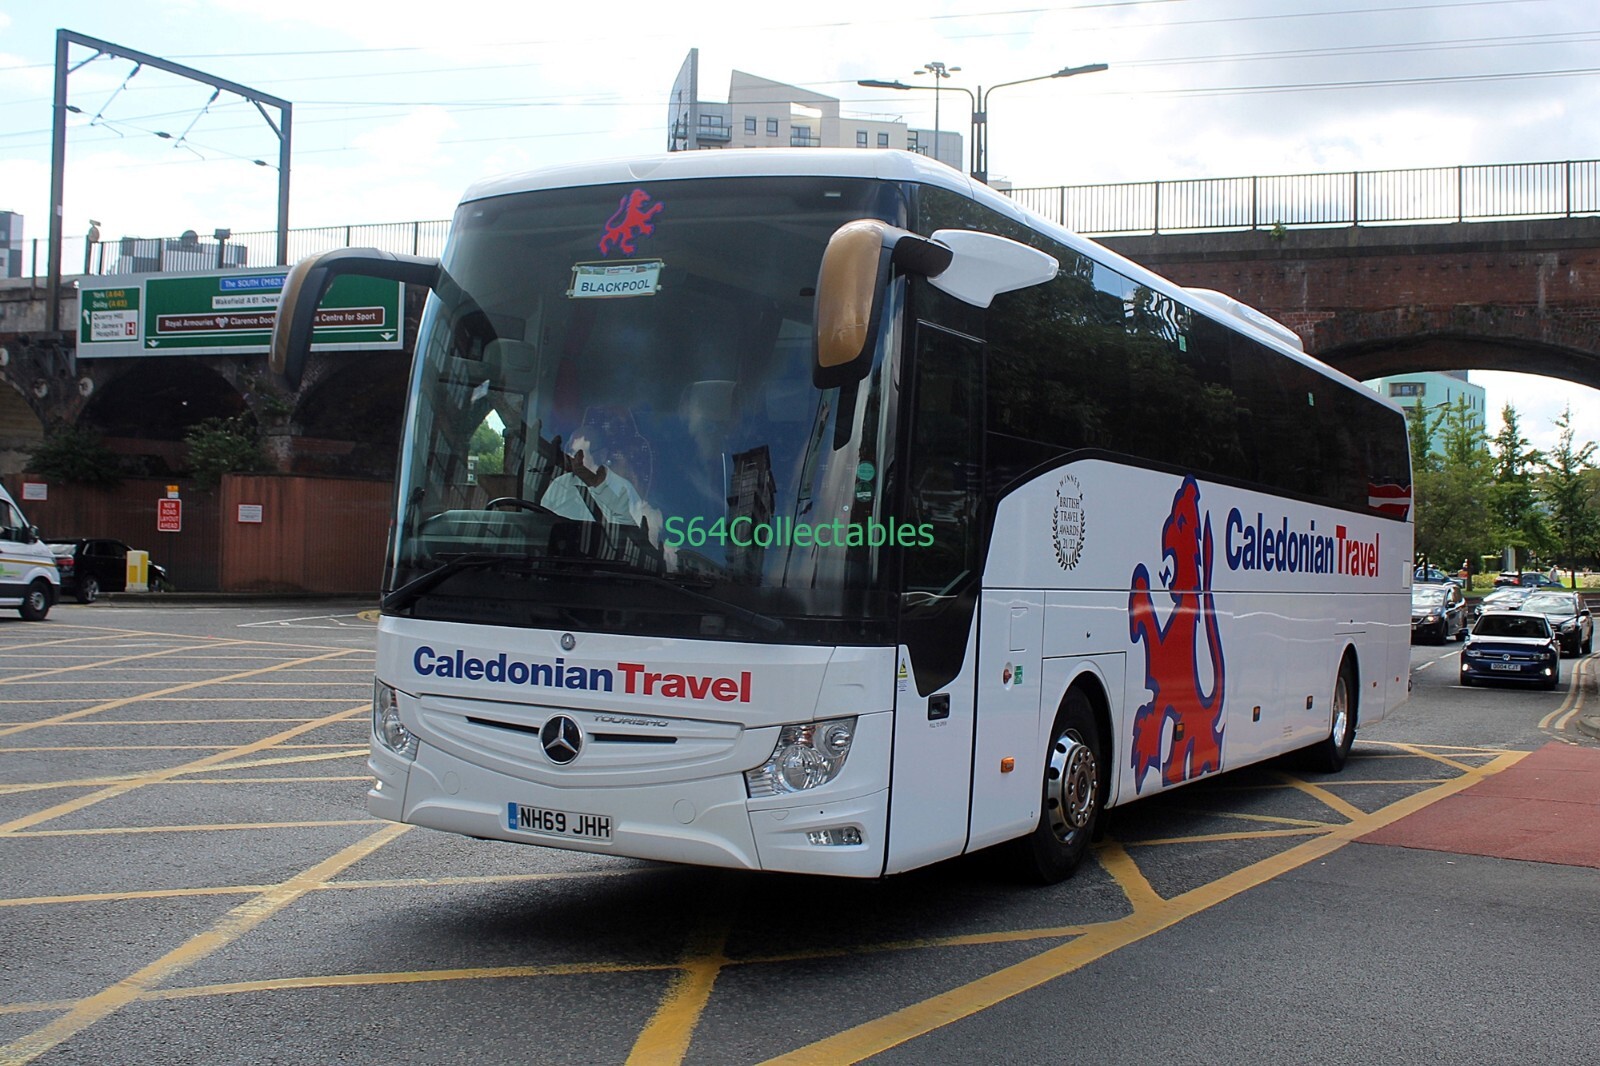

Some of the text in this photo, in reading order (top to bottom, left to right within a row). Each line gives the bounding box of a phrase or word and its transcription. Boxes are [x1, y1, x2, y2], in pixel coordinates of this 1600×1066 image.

[225, 280, 236, 288] The
[238, 278, 259, 287] SOUTH
[581, 279, 650, 292] BLACKPOOL
[262, 296, 280, 304] Dews
[165, 319, 182, 328] Royal
[183, 318, 214, 327] Armouries
[230, 316, 258, 325] Clarence
[321, 313, 343, 322] Centre
[345, 312, 355, 321] for
[356, 311, 376, 321] Sport
[127, 322, 135, 335] H
[1059, 474, 1080, 489] WINNER
[1059, 496, 1080, 510] BRITISH
[1060, 510, 1079, 523] TRAVEL
[1060, 525, 1080, 537] AWARDS
[1225, 507, 1380, 577] Caledonian Travel
[413, 646, 752, 703] Caledonian Travel
[594, 714, 669, 727] TOURISMO
[520, 807, 610, 838] NH69 JHH
